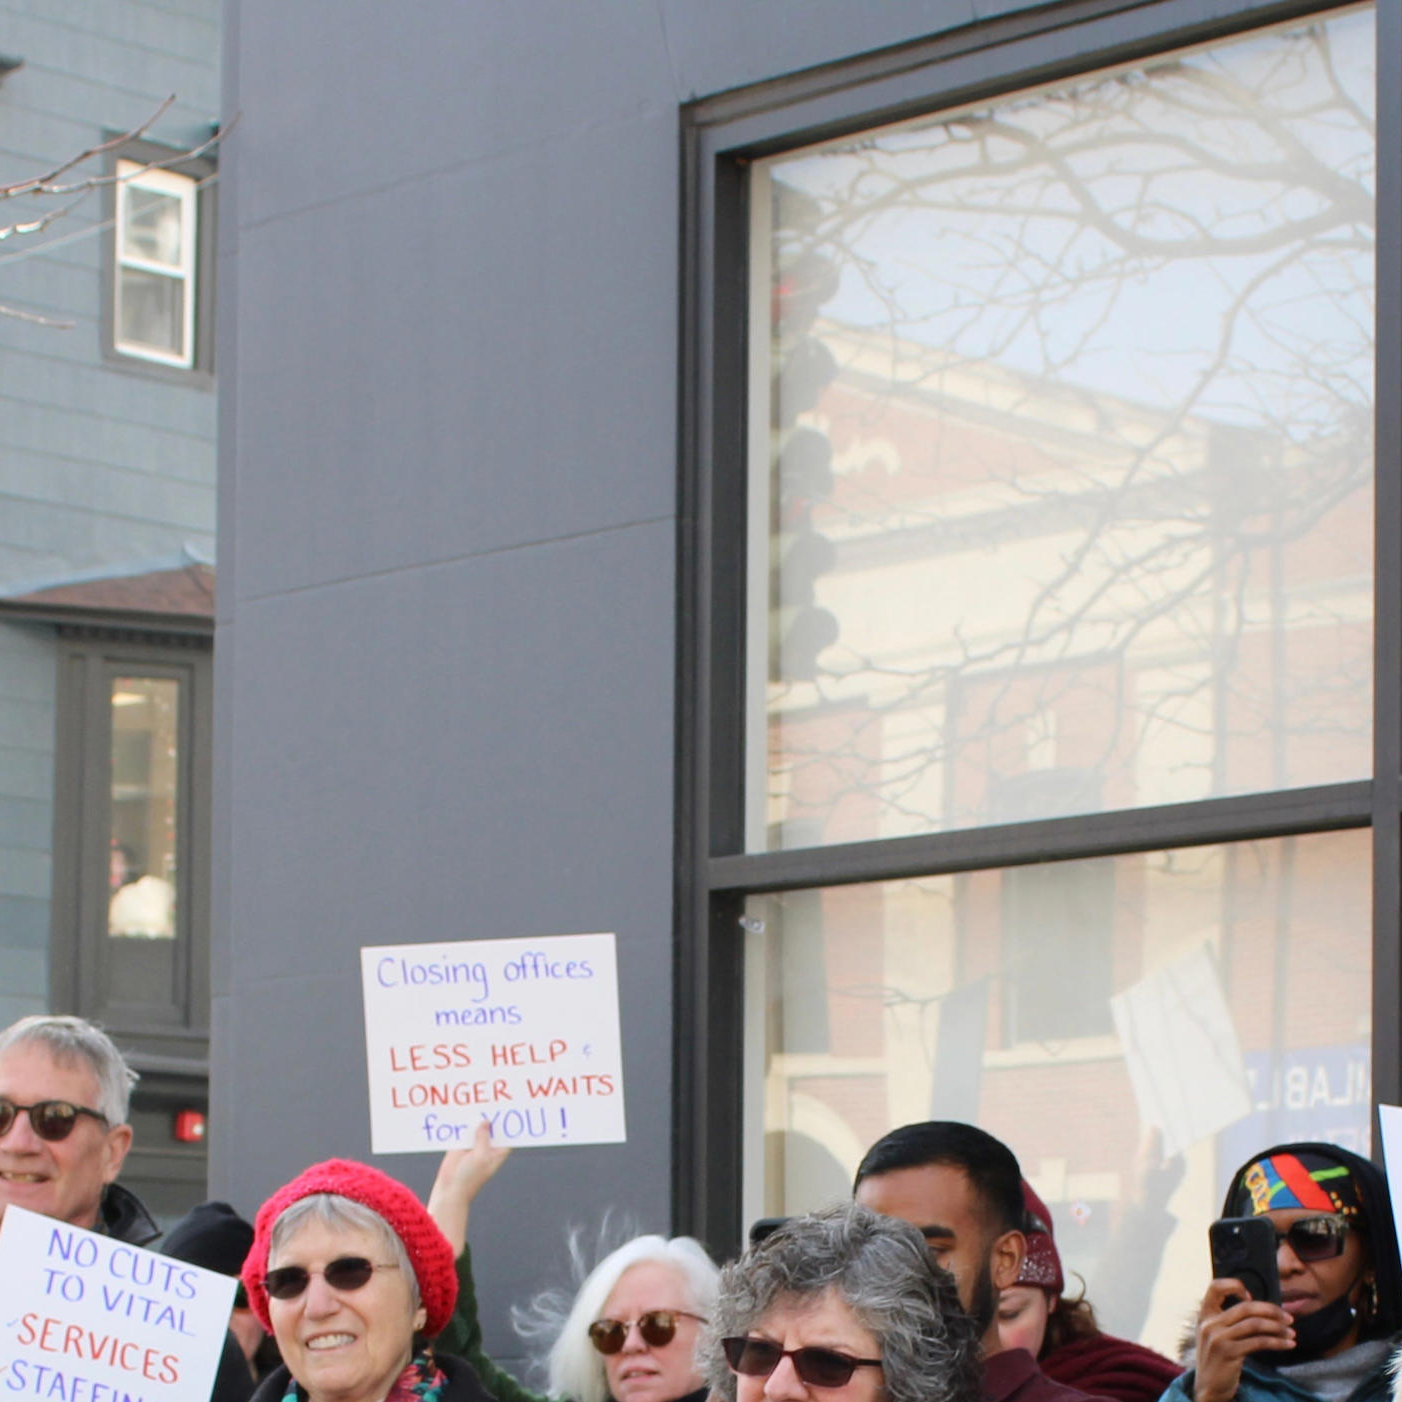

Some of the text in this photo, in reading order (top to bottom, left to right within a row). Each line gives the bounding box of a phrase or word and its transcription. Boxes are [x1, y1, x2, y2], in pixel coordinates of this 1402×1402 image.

[377, 951, 594, 1003] Closing offices
[435, 1004, 523, 1027] means
[390, 1043, 472, 1072] LESS
[491, 1039, 568, 1067] HELP
[392, 1074, 614, 1109] LONGER WAITS
[422, 1113, 468, 1142] for
[48, 1228, 200, 1300] NO CUTS
[43, 1268, 197, 1337] TO VITAL
[17, 1312, 180, 1385] SERVICES
